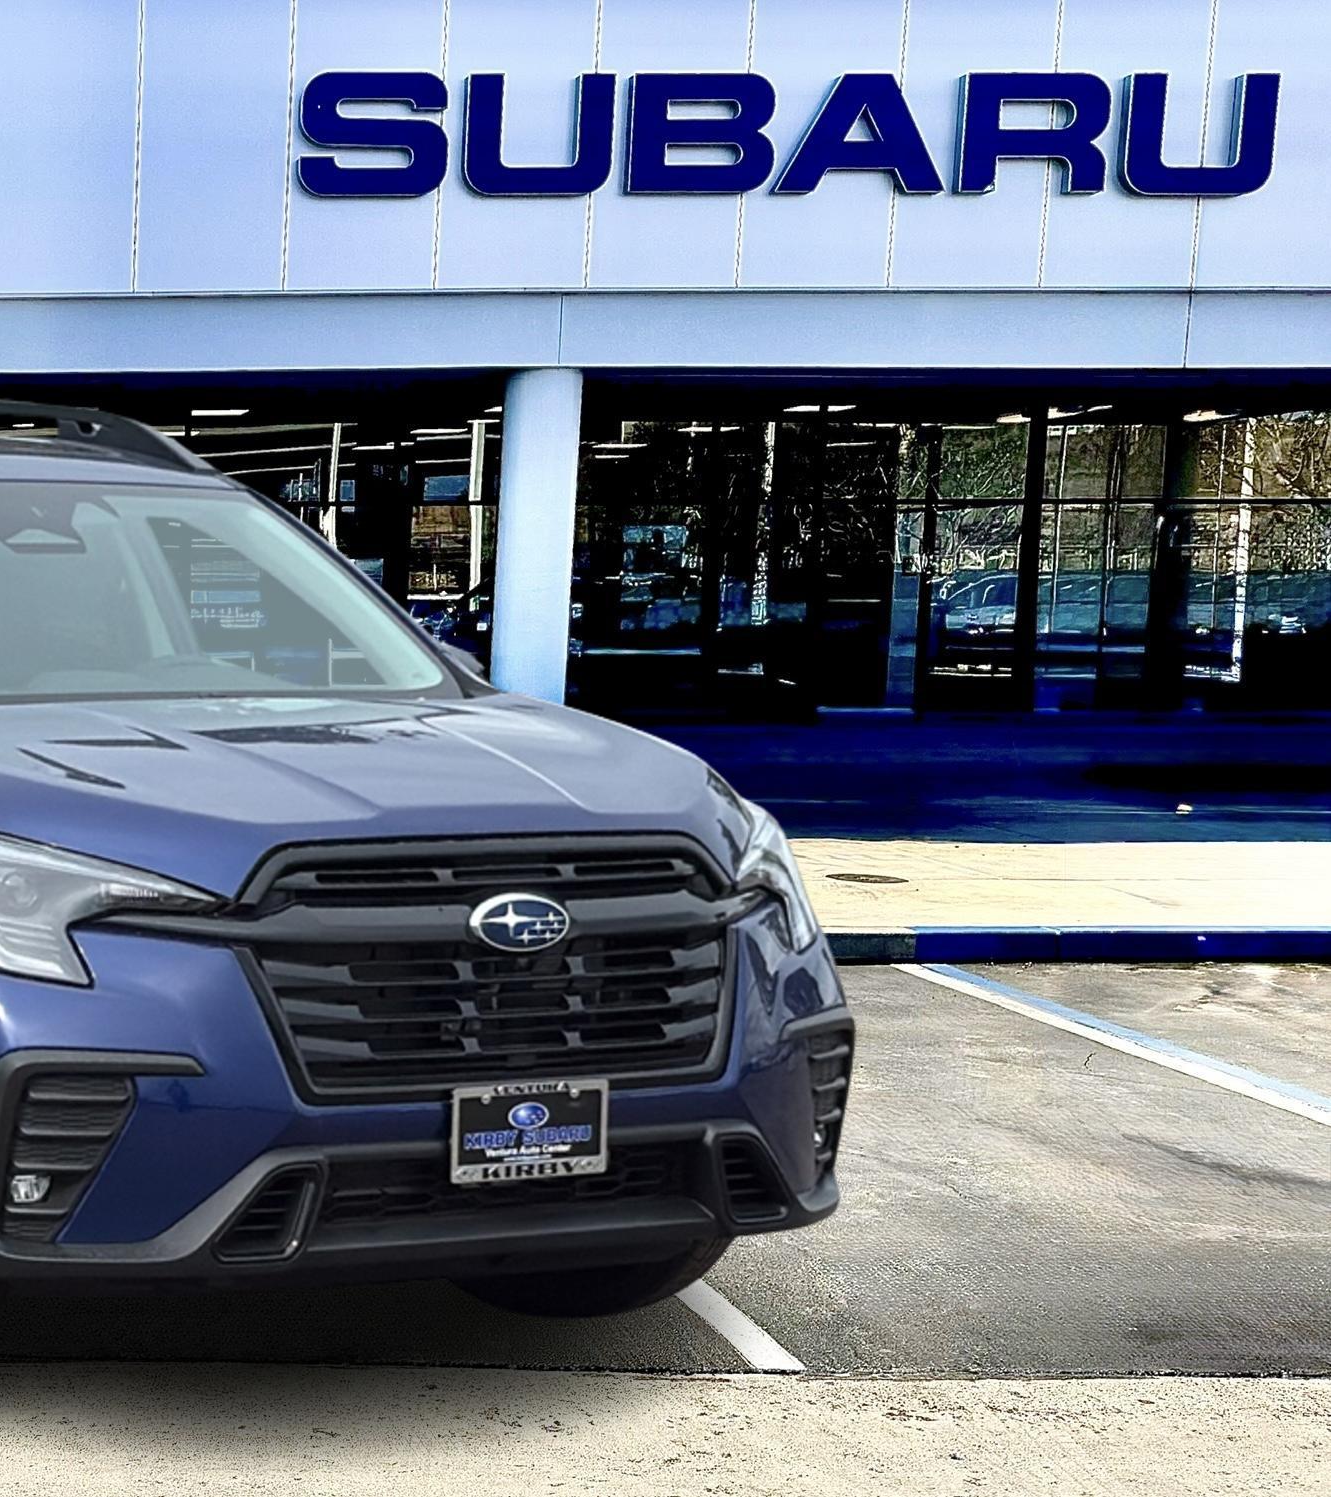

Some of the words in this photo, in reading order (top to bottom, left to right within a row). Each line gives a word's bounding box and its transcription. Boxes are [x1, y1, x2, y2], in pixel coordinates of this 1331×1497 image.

[297, 71, 1281, 198] SUBARU
[464, 1130, 518, 1149] KIRBY
[523, 1125, 591, 1144] SUBARU
[485, 1147, 518, 1158] Ventura
[519, 1144, 540, 1155] Auto
[542, 1143, 572, 1153] Center
[482, 1161, 576, 1179] KIRBY
